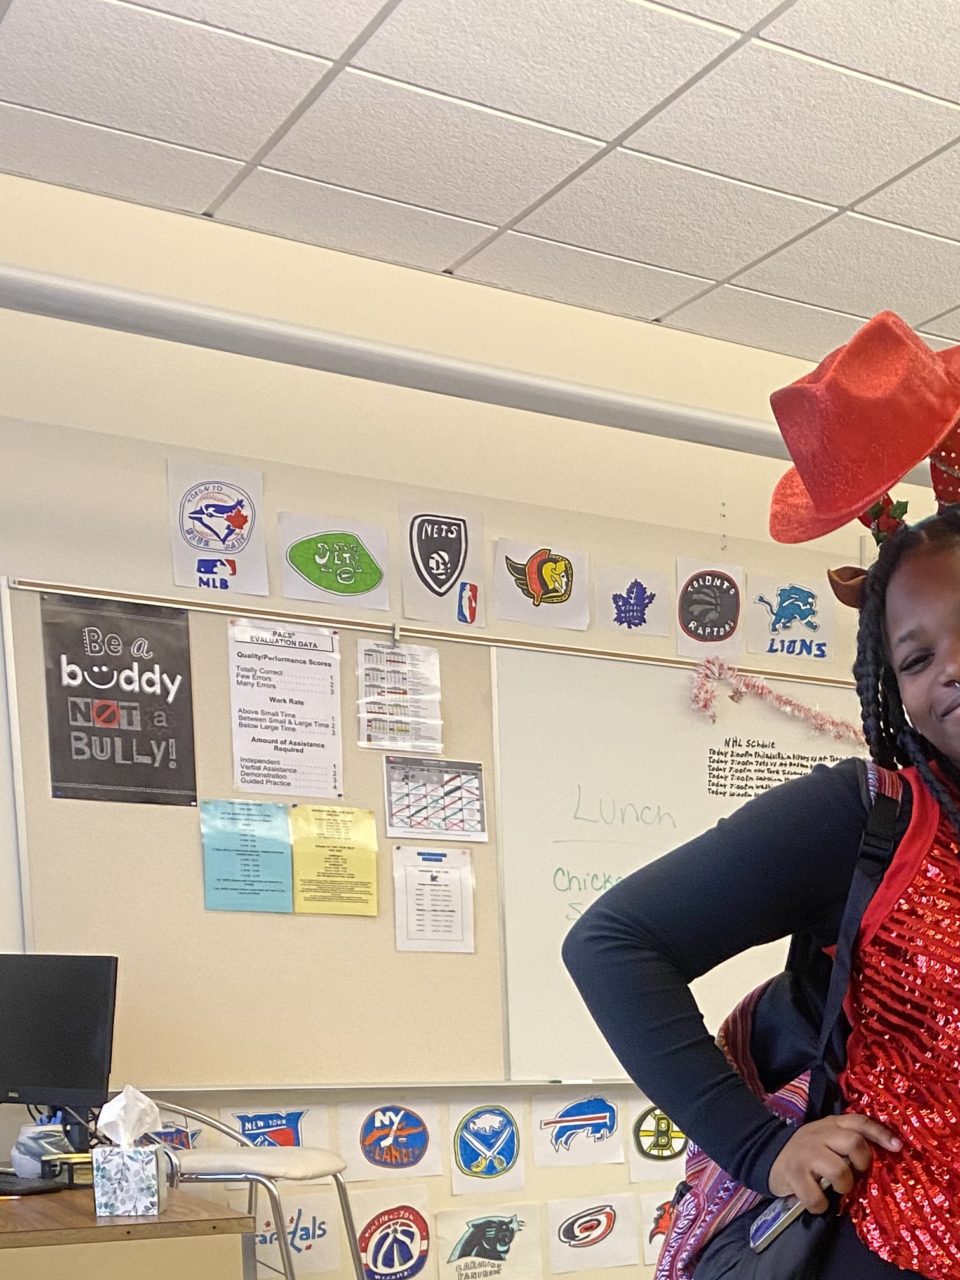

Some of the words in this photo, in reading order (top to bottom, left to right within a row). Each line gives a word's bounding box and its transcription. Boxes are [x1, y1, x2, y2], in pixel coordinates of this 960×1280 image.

[422, 522, 459, 540] NETS
[198, 576, 230, 590] MLB
[688, 619, 735, 637] RAPTORS
[83, 626, 123, 656] Be
[131, 637, 153, 659] a
[250, 636, 296, 646] EVALUATION
[298, 640, 318, 649] DATA
[766, 637, 828, 658] LIONS
[237, 652, 306, 665] Quality/Performance
[309, 659, 332, 667] Scores
[236, 666, 257, 675] Totally
[60, 654, 182, 704] buddy
[236, 680, 254, 688] Many
[289, 698, 304, 706] Rate
[67, 696, 141, 731] NOT
[153, 710, 168, 727] a
[260, 709, 278, 717] Small
[238, 715, 266, 723] Between
[269, 717, 286, 725] Small
[294, 720, 312, 728] Large
[260, 724, 278, 732] Large
[251, 736, 278, 744] Amount
[288, 740, 325, 748] Assistance
[724, 737, 743, 748] NHL
[70, 731, 177, 769] BULLY!
[274, 745, 304, 754] Required
[240, 757, 280, 765] Independent
[241, 771, 287, 779] Demonstration
[263, 766, 297, 774] Assistance
[266, 779, 291, 787] Practice
[574, 784, 677, 829] Lunch
[245, 1120, 264, 1131] NEW
[269, 1118, 287, 1126] YORK
